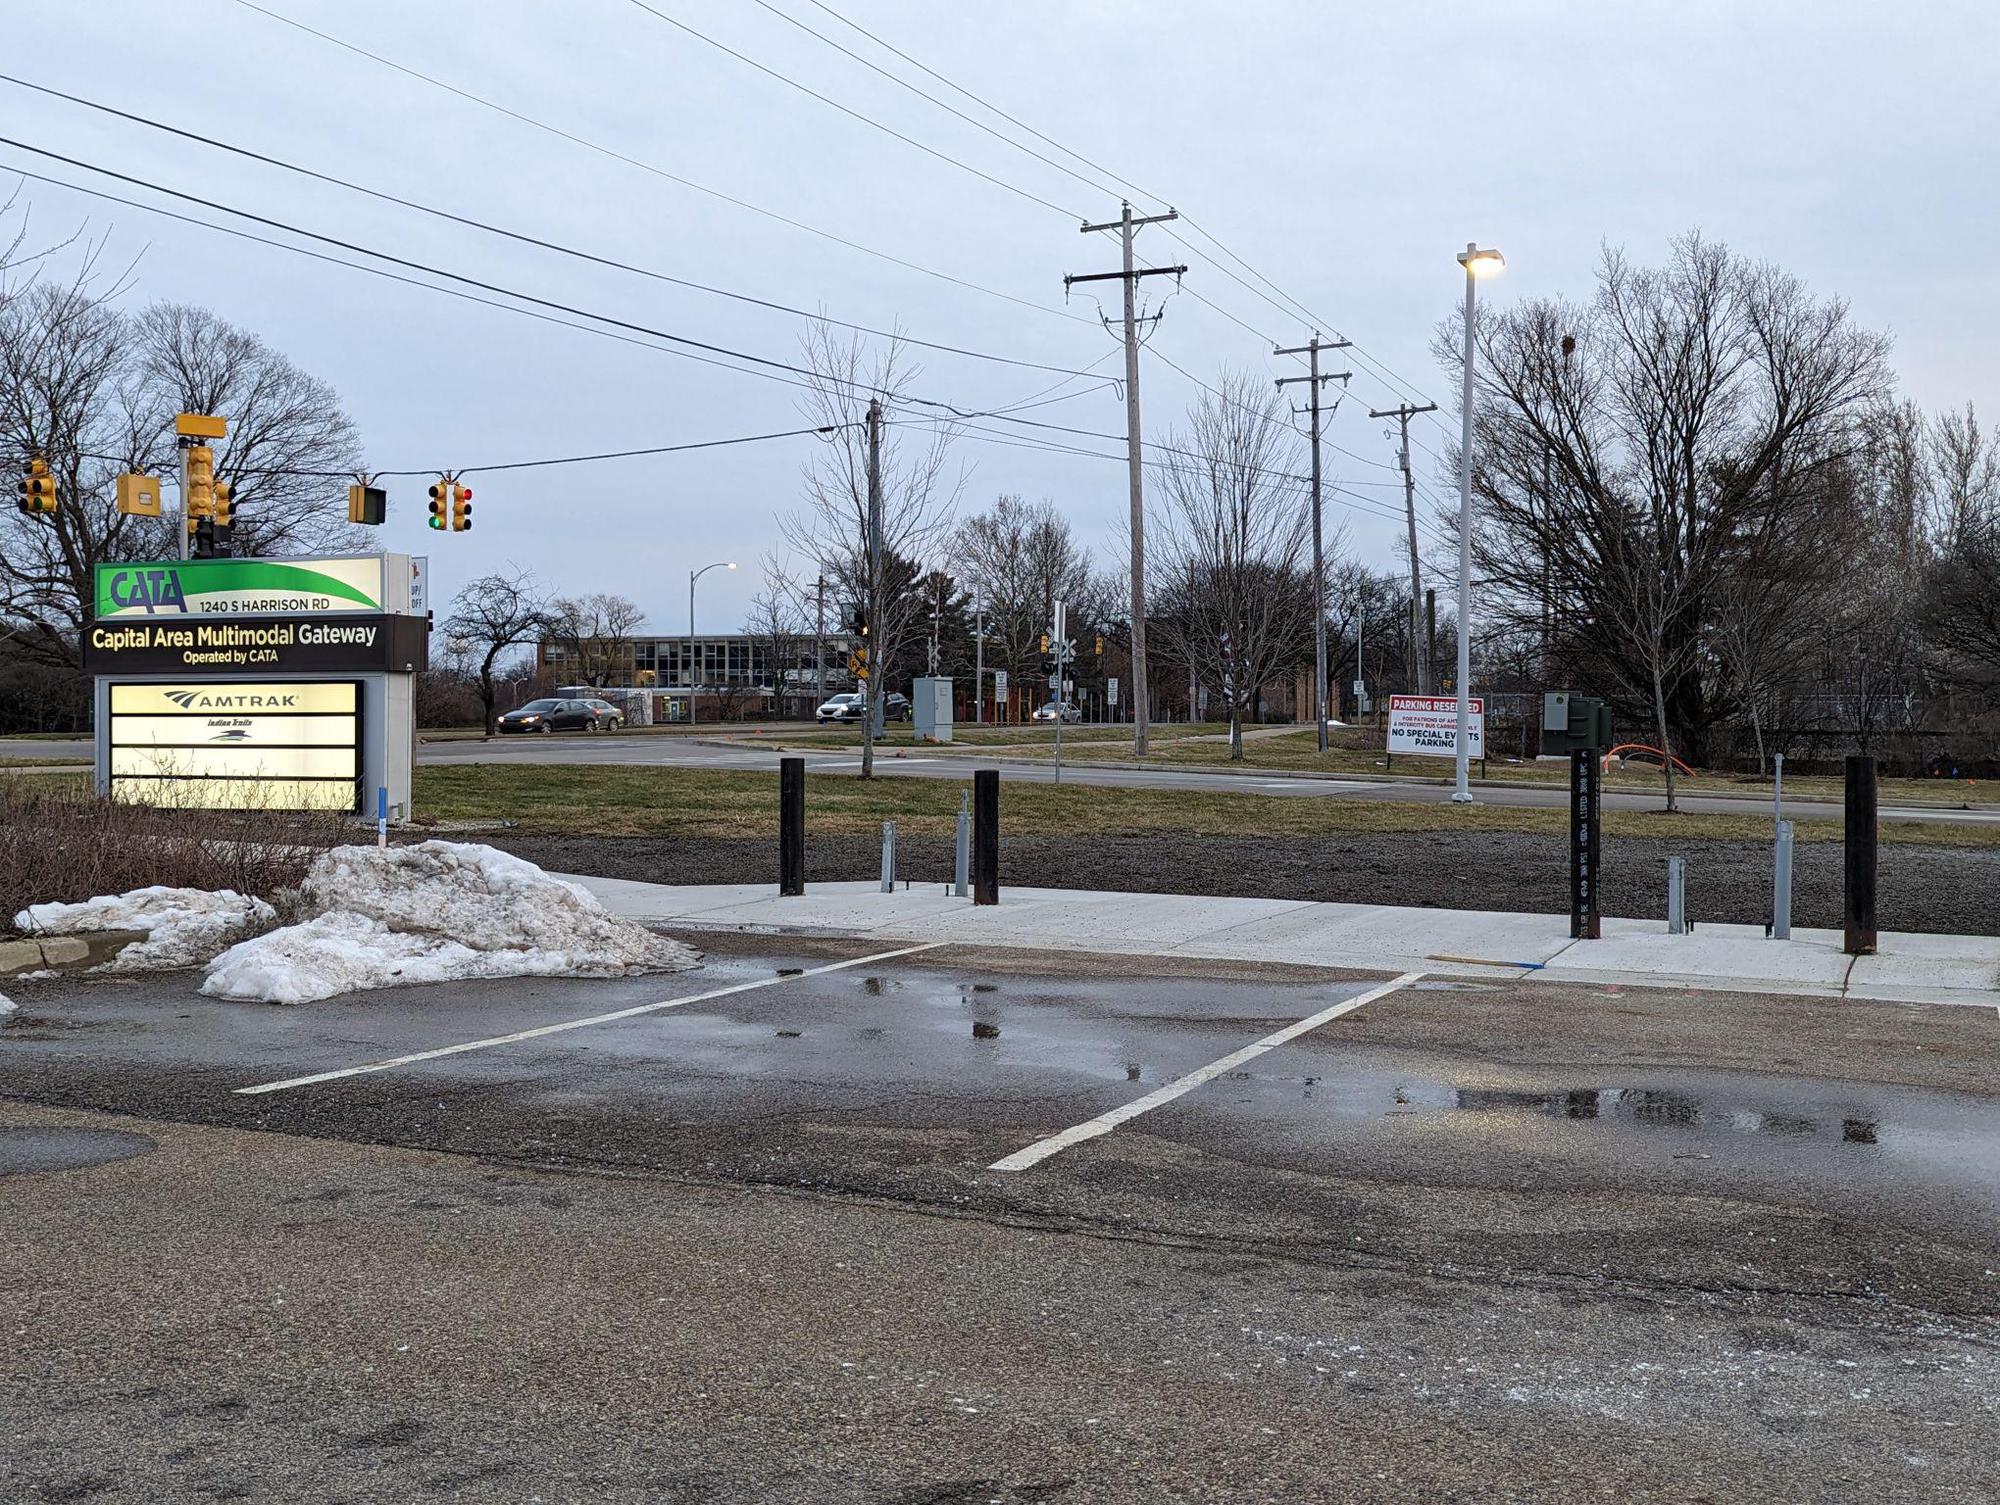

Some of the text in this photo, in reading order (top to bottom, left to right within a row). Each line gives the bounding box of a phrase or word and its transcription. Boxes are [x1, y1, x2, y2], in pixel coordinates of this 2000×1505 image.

[111, 570, 188, 613] CATA
[200, 598, 330, 613] 1240 S HARRISON RD
[92, 623, 377, 652] Capital Area Multimodal Gateway
[183, 649, 279, 665] Operated by CATA
[199, 695, 295, 707] AMTRAK
[1393, 699, 1480, 712] PARKING RESEED
[1407, 730, 1442, 738] SPECIAL
[1444, 731, 1480, 741] EVTS
[1415, 739, 1454, 747] PARKING
[1579, 795, 1588, 819] LISTED
